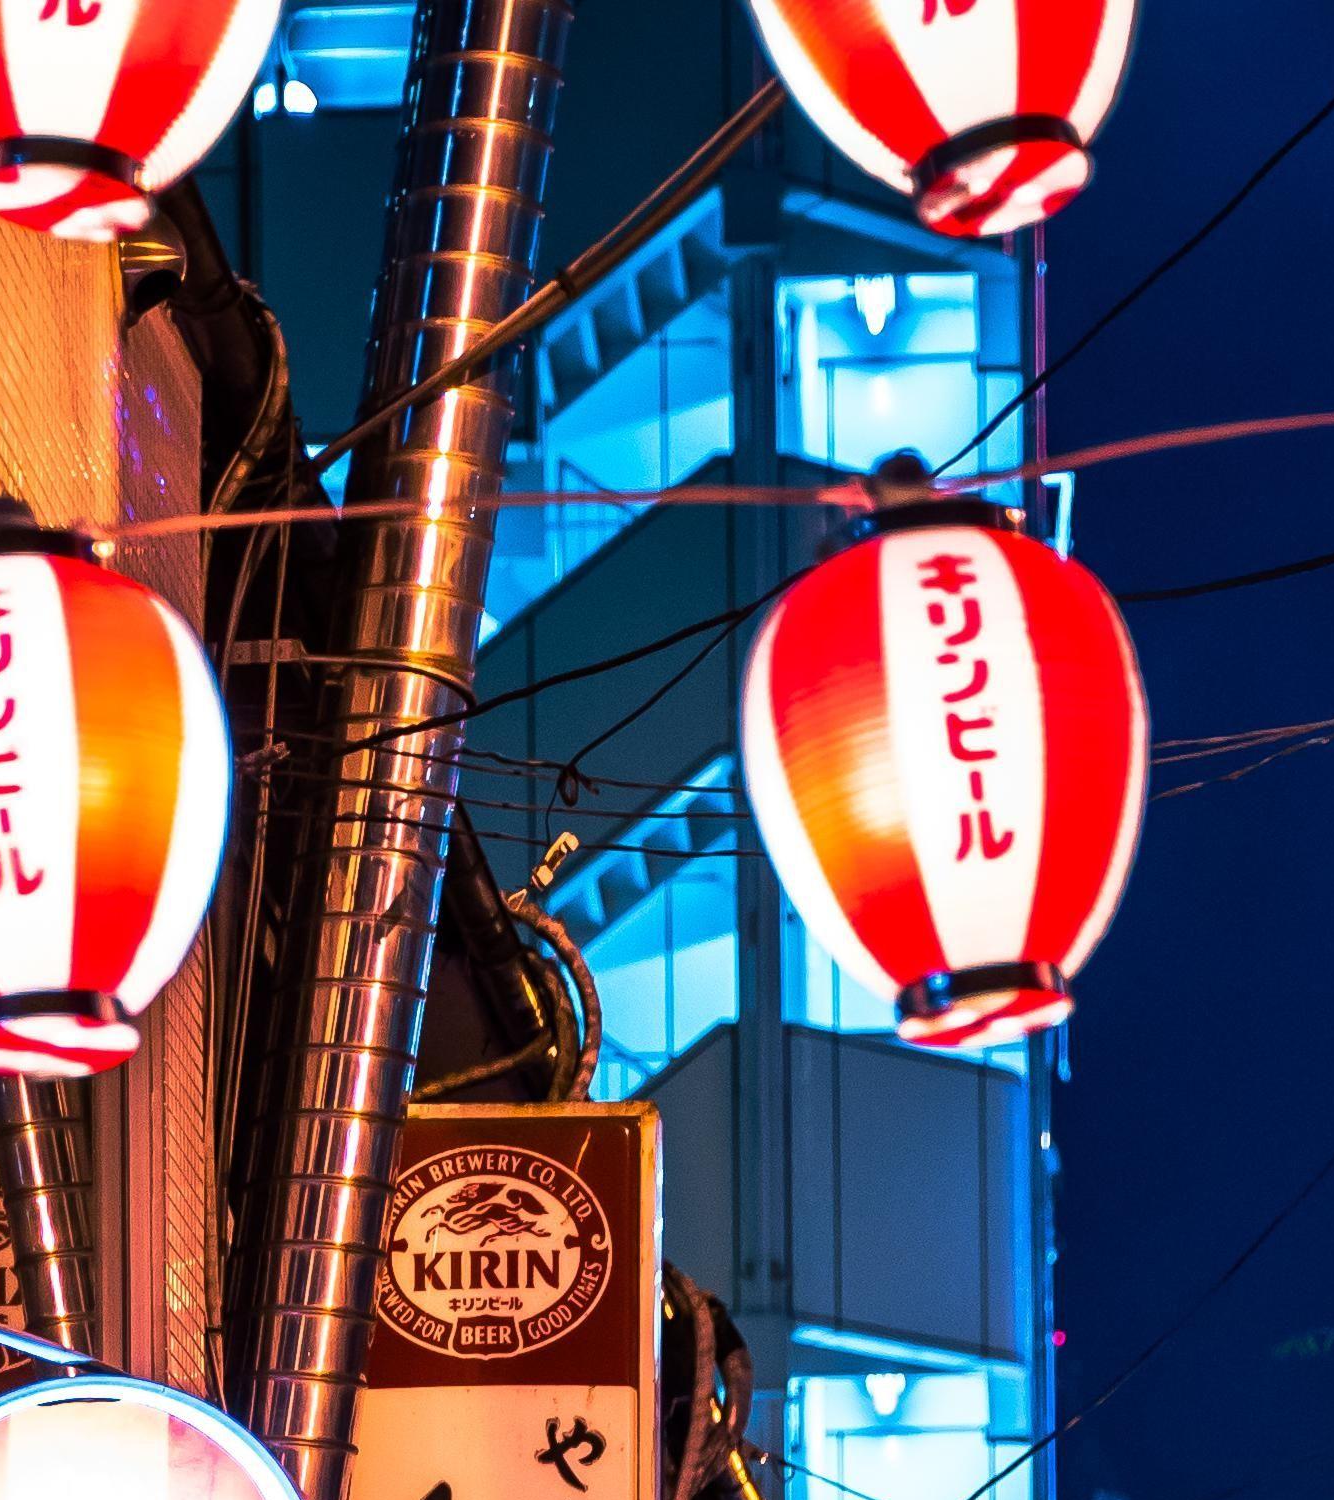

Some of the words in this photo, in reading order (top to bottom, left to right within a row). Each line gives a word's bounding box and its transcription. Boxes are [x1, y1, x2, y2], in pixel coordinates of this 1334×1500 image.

[428, 1151, 523, 1184] BREWERY
[413, 1250, 561, 1293] KIRIN
[448, 1296, 524, 1312] キリンビール
[527, 1306, 574, 1342] GOOD
[567, 1260, 605, 1310] TIMES
[412, 1315, 447, 1344] FOR
[460, 1325, 512, 1346] BEER
